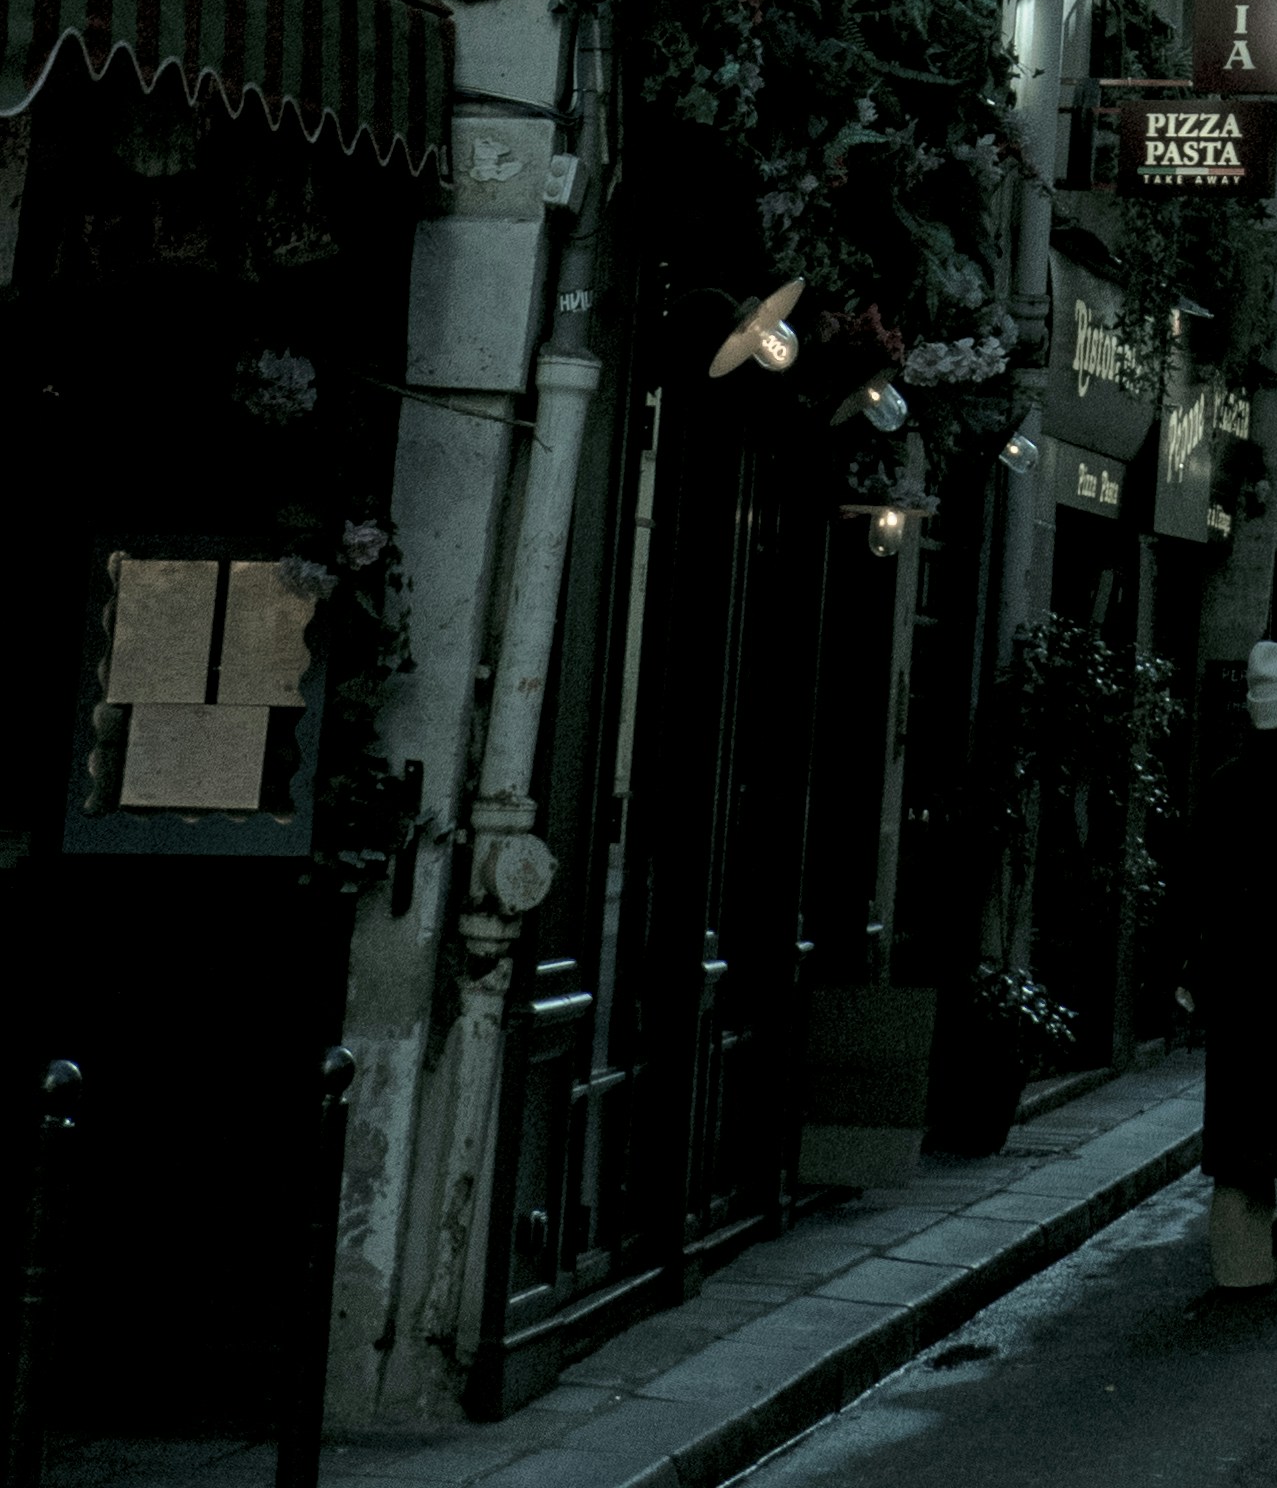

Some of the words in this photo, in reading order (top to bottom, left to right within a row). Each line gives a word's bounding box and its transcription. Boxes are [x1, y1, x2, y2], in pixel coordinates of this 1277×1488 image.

[1145, 113, 1243, 138] PIZZA
[1145, 141, 1241, 166] PASTA
[1143, 175, 1183, 185] TAKE
[1195, 175, 1240, 185] AWAY
